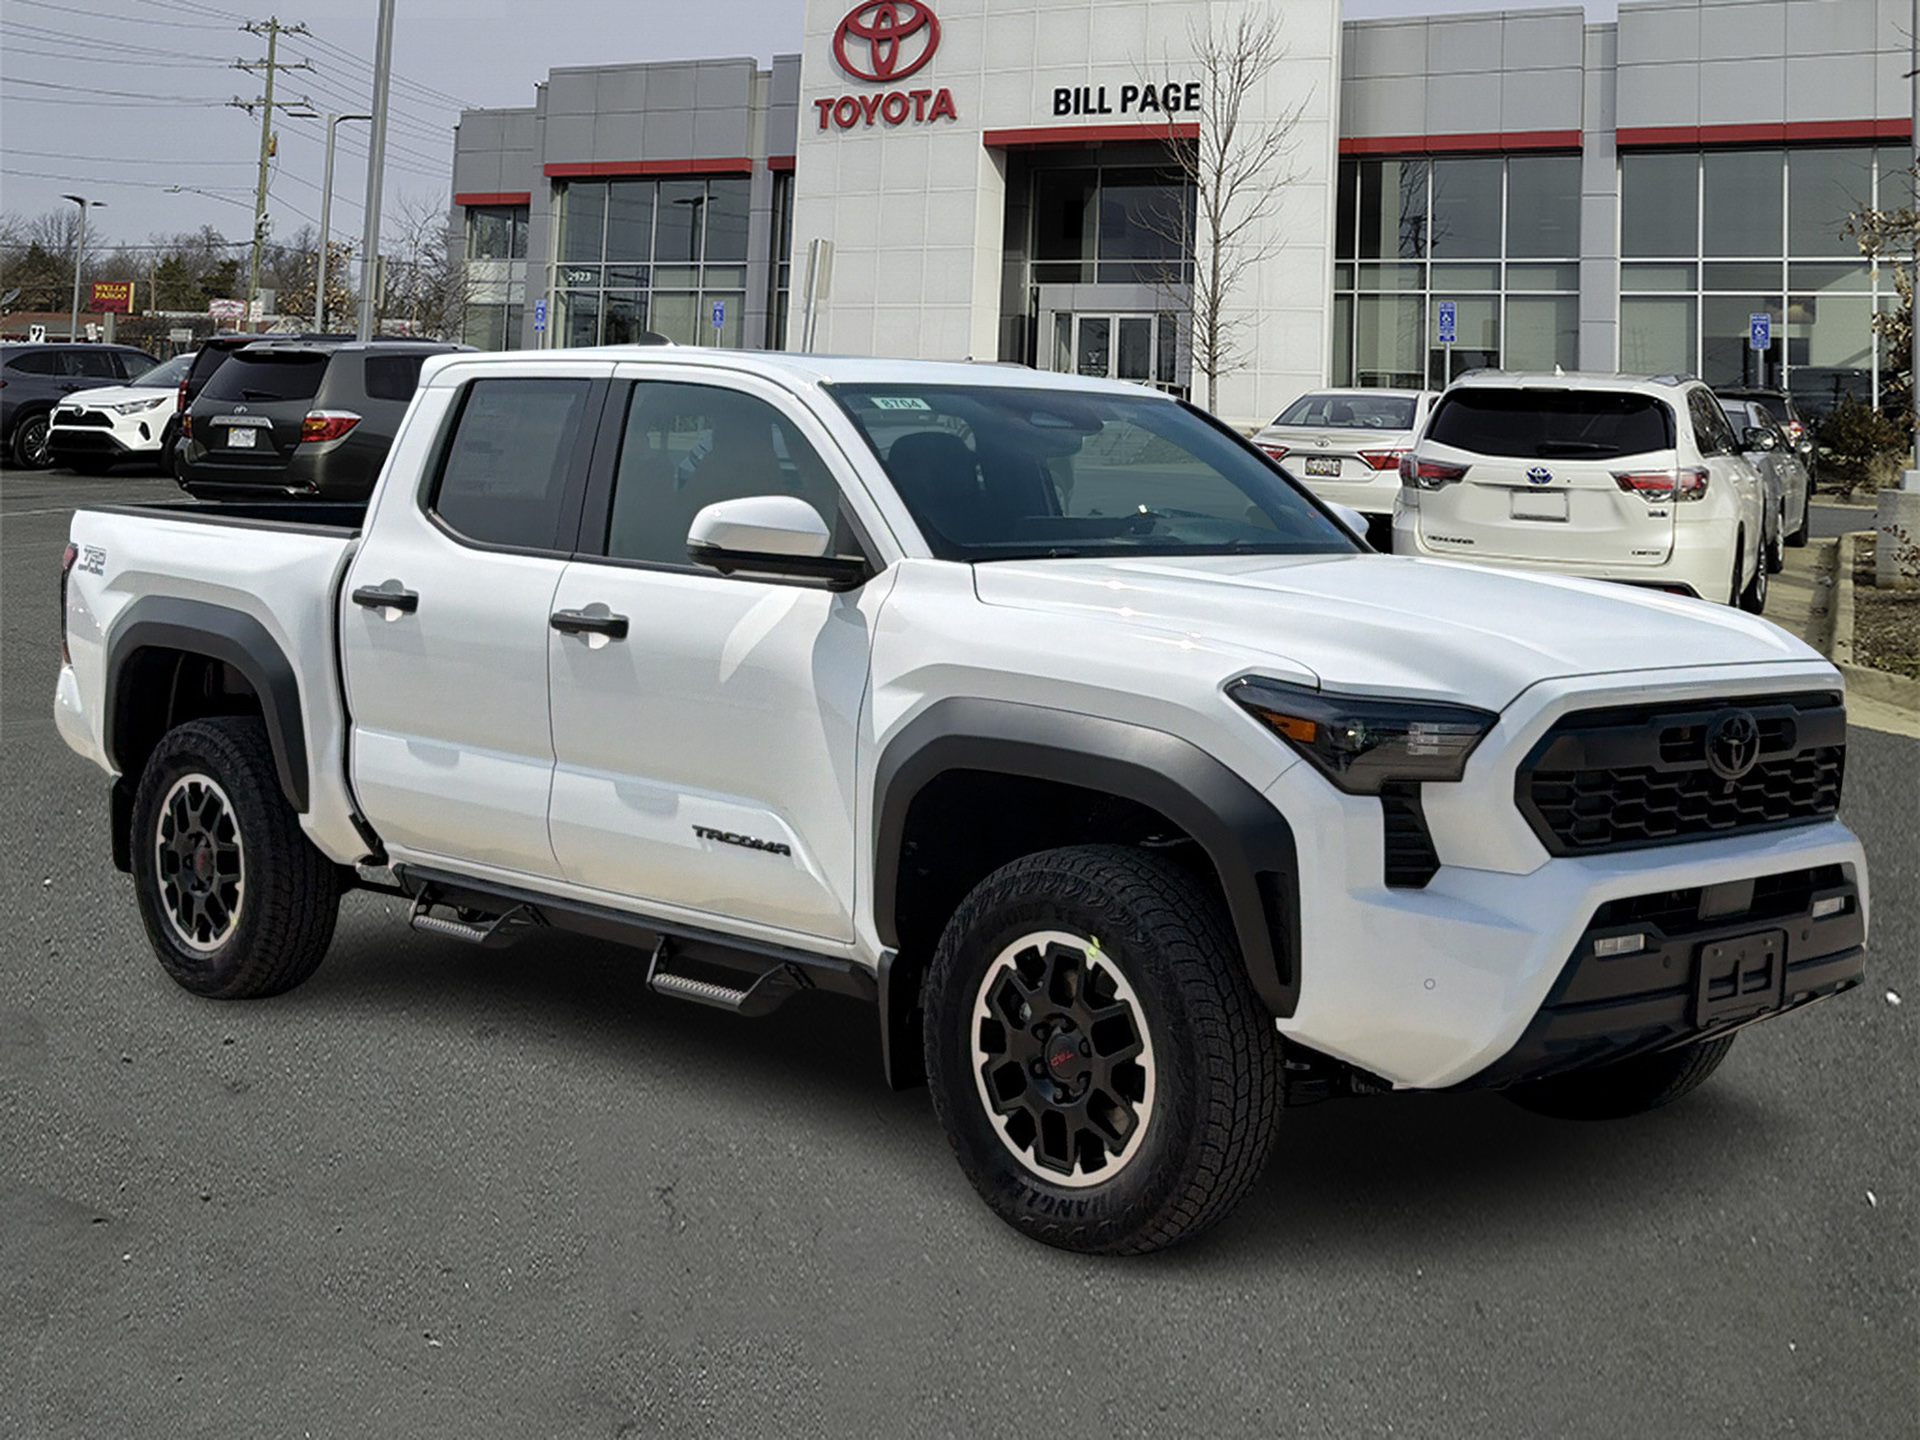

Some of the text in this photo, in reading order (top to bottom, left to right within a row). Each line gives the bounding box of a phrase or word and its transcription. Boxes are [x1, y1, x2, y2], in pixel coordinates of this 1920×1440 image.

[814, 88, 958, 129] TOYOTA
[1053, 83, 1201, 116] BILL PAGE
[95, 291, 127, 299] FARGO
[880, 399, 922, 409] 8704
[692, 824, 791, 857] TACOMA
